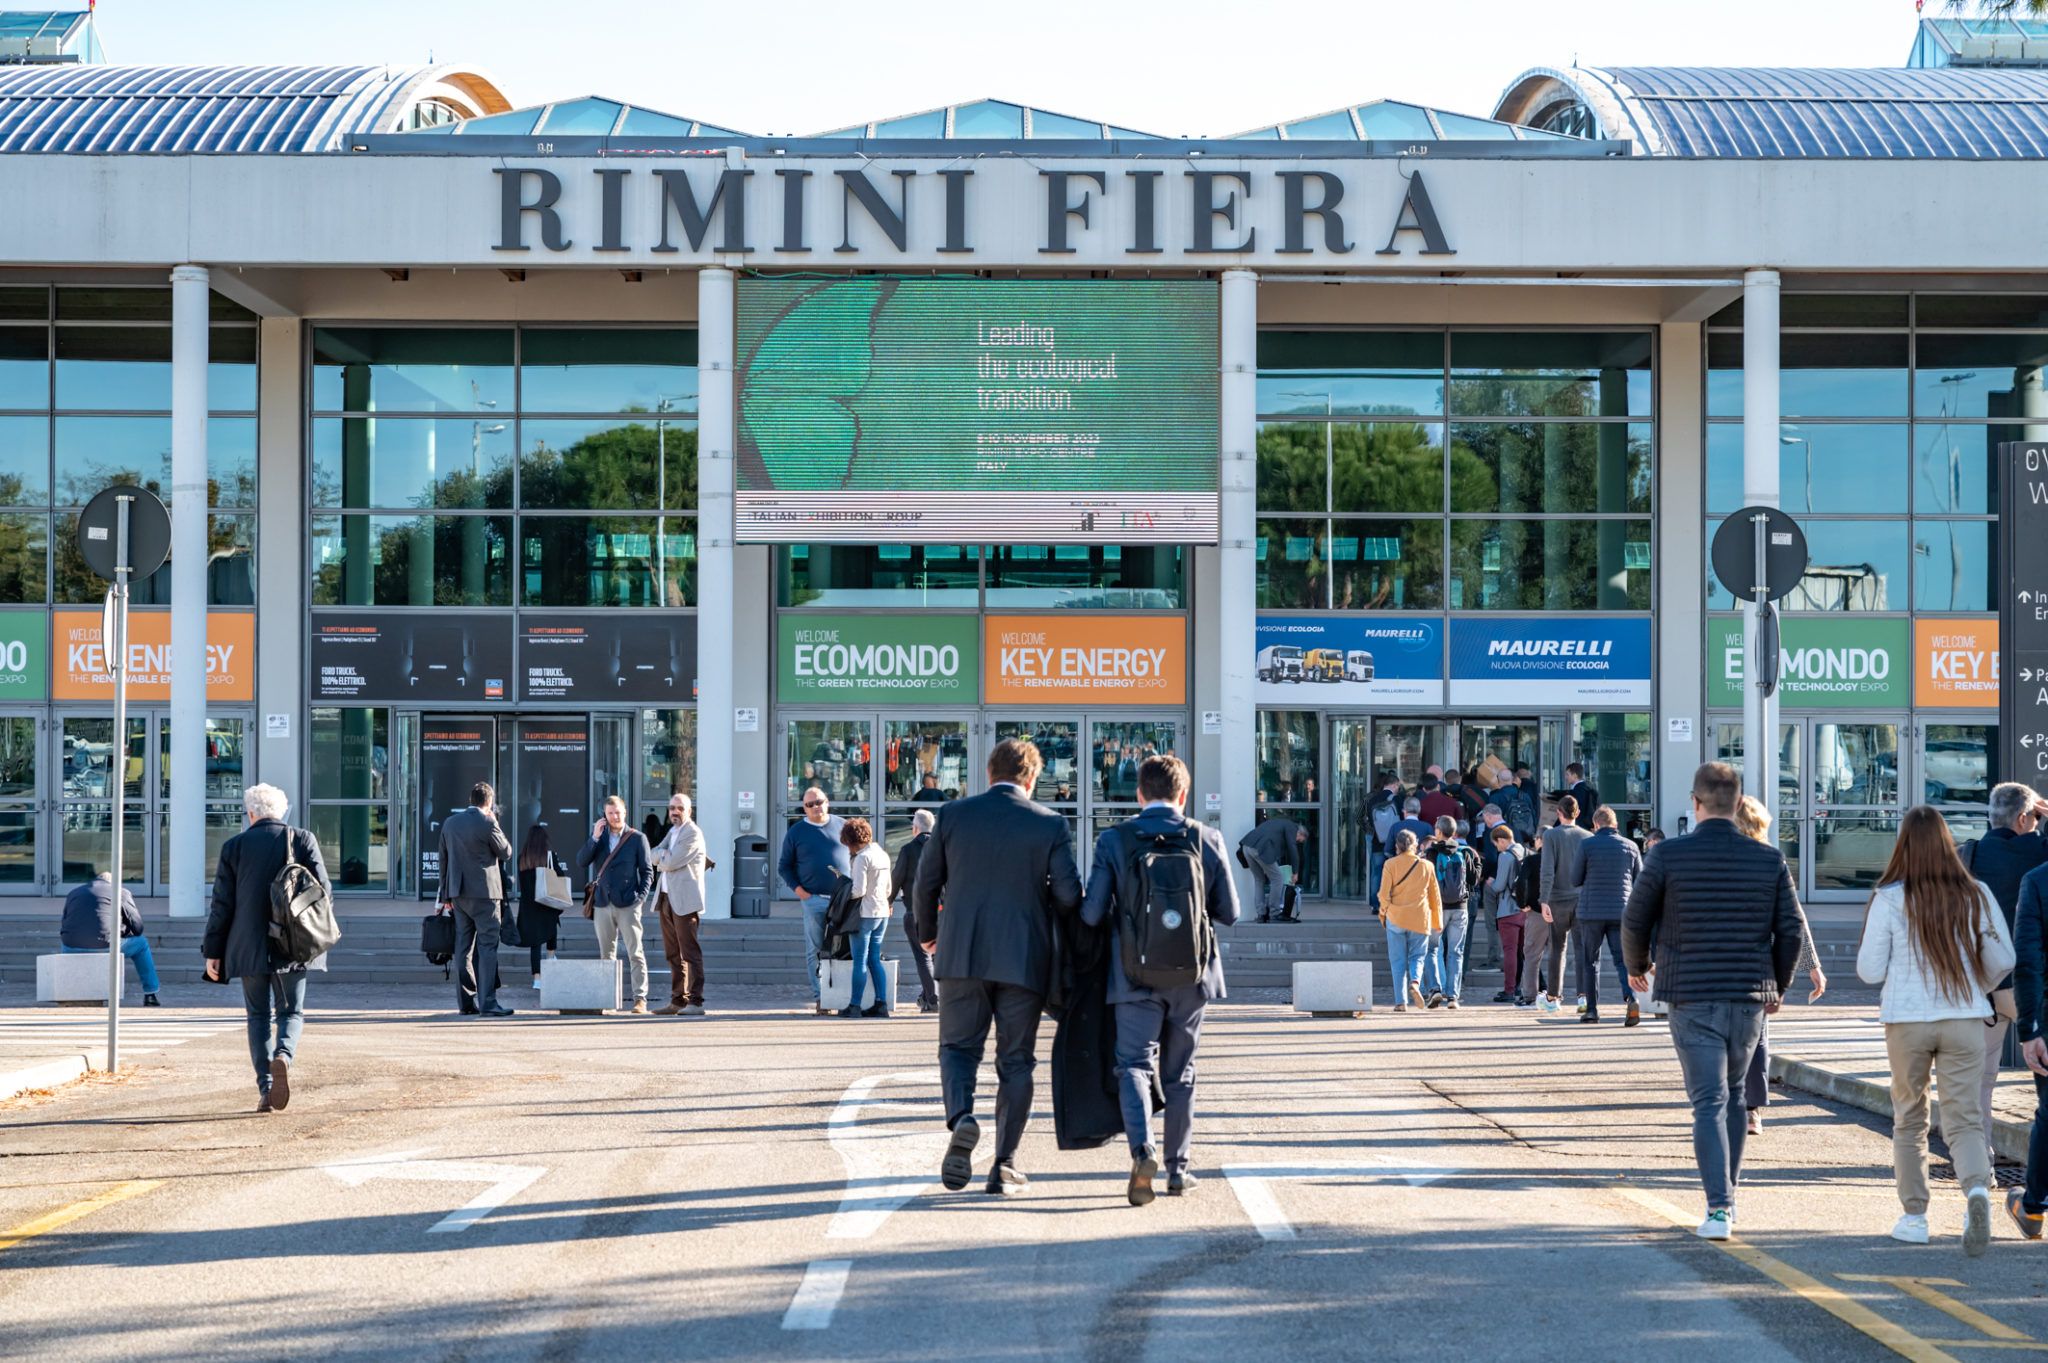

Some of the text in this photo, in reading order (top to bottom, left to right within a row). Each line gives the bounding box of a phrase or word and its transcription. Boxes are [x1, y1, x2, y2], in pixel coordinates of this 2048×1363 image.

[491, 168, 1457, 255] RIMINI FIERA
[978, 320, 1054, 352] Leading
[978, 353, 1118, 383] the ecological
[977, 386, 1076, 410] transition.
[1003, 433, 1069, 443] NOVEMBER
[749, 511, 797, 521] TALIAN
[1288, 625, 1325, 633] ECOLOGIA
[1365, 629, 1424, 638] MAURELLI
[795, 630, 839, 643] WELCOME
[1001, 632, 1046, 645] WELCOME
[1931, 635, 1976, 648] WELCOME
[1488, 640, 1612, 656] MAURELLI
[68, 644, 234, 673] KE ENGY
[795, 644, 959, 676] ECOMONDO
[1001, 648, 1166, 676] KEY ENERGY
[1725, 647, 1889, 679] EMONDO
[1931, 651, 1984, 679] KEY
[321, 667, 335, 675] FORD
[529, 668, 542, 676] FORD
[1491, 661, 1610, 670] NUOVA DIVISIONE ECOLOGIA
[69, 674, 89, 684] THE
[795, 678, 959, 688] THE GREEN TECHNOLOGY EXPO
[1002, 678, 1167, 688] THE RENEWABLE ENERGY EXPO
[1786, 682, 1858, 691] TECHNOLOGY
[1860, 682, 1889, 692] EXPO
[1932, 681, 2000, 691] THE RENEWA
